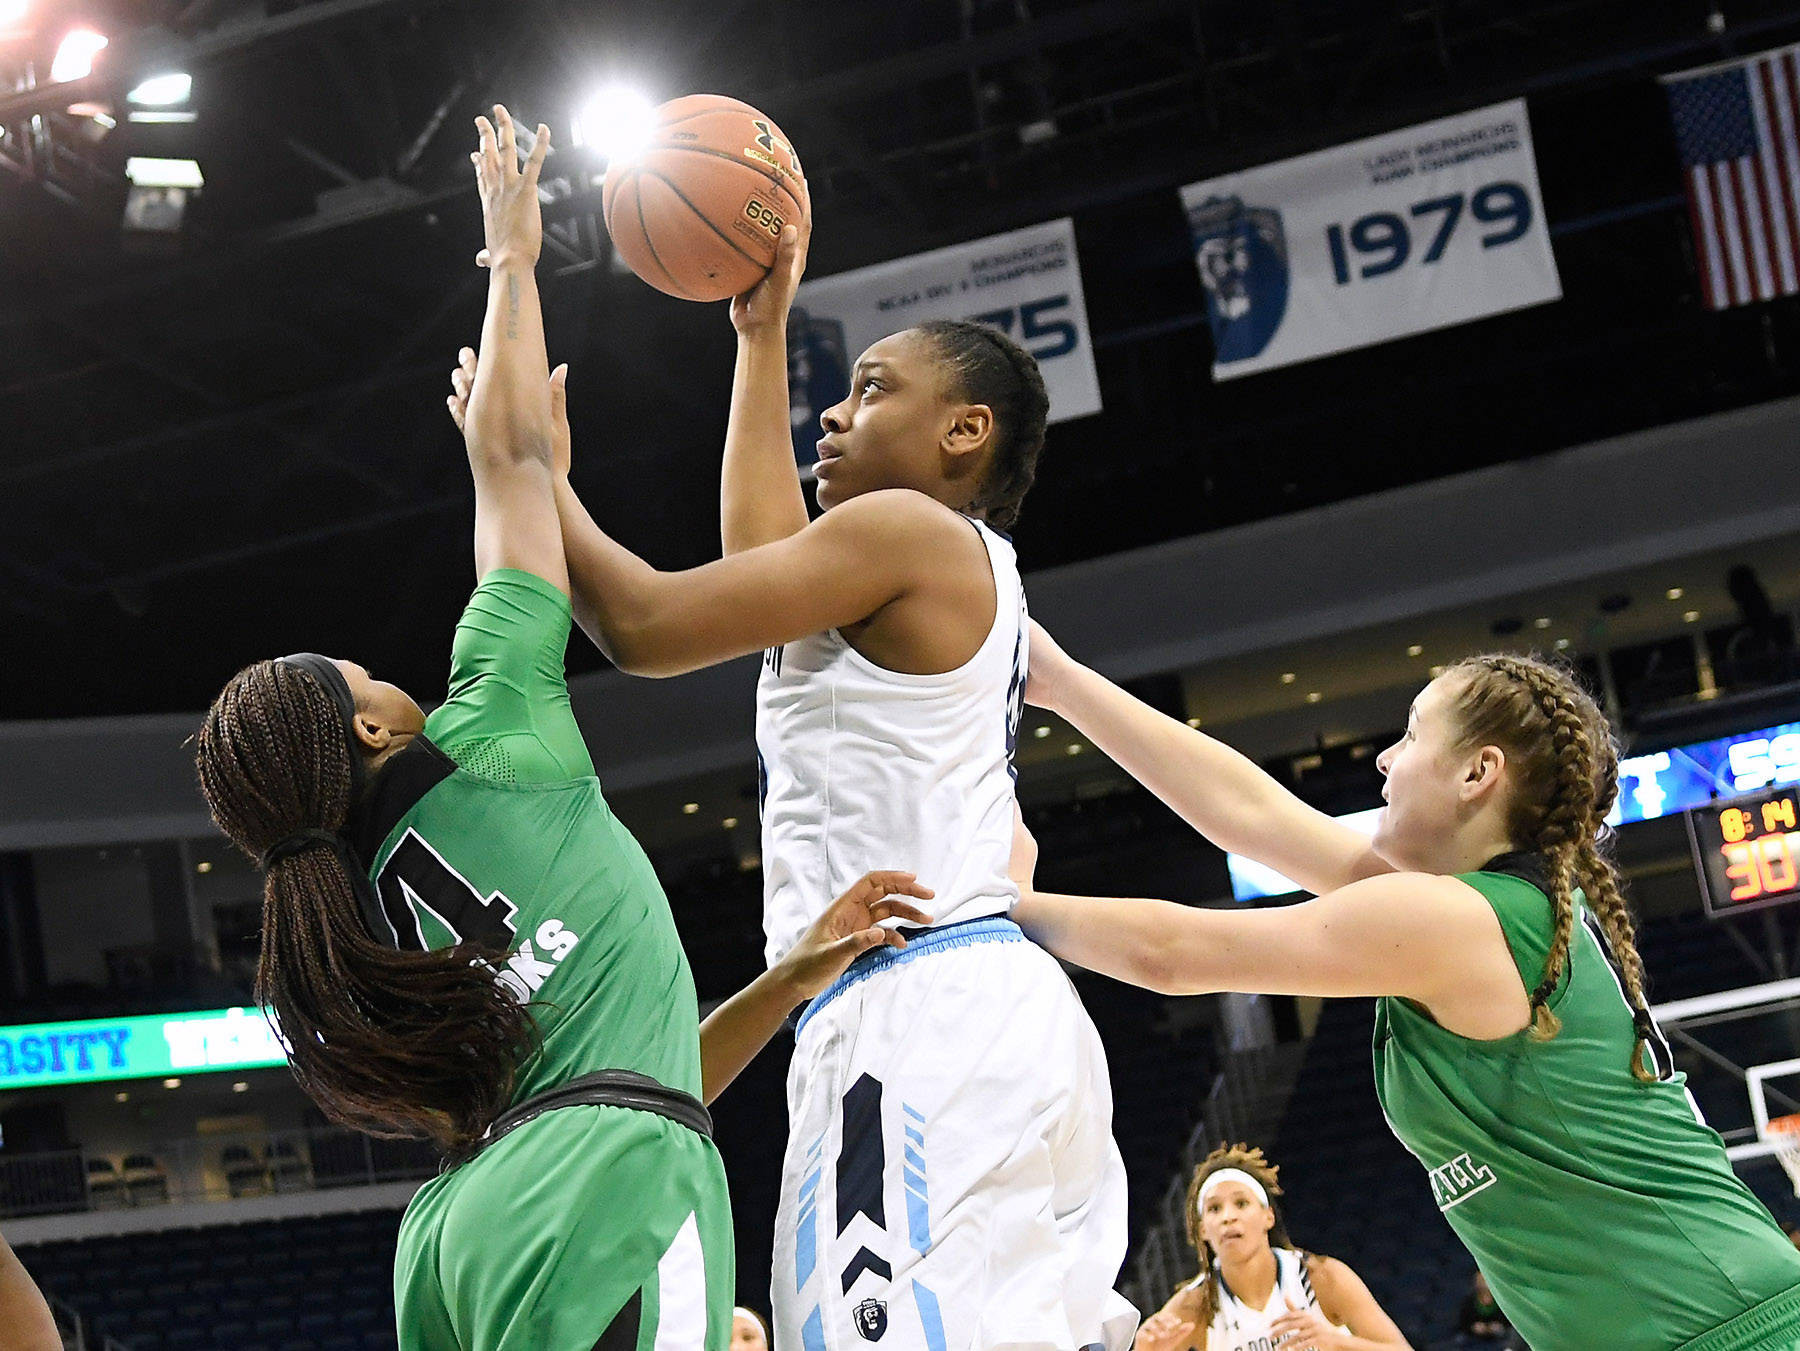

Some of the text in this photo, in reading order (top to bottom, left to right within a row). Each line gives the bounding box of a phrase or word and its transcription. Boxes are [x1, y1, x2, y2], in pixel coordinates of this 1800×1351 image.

[745, 199, 784, 237] 695
[1326, 179, 1534, 286] 1979
[1720, 831, 1799, 901] 30
